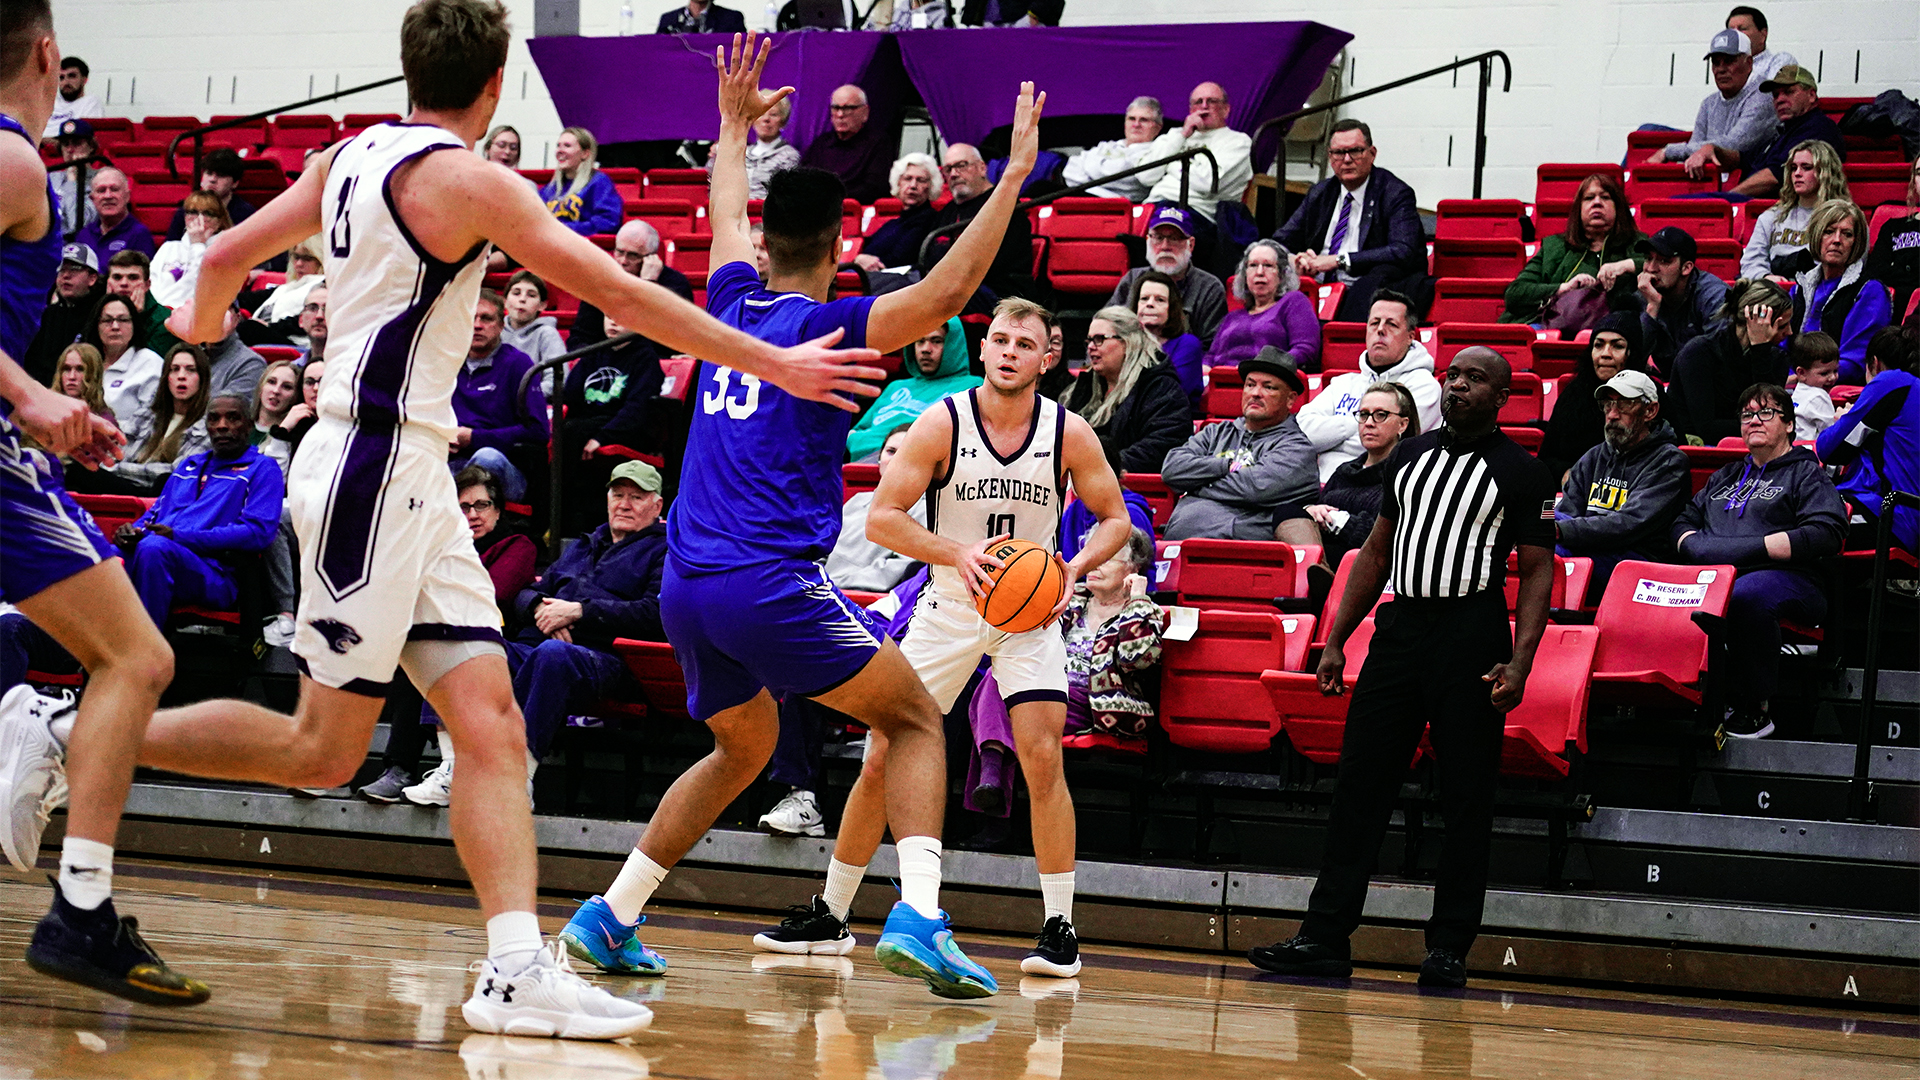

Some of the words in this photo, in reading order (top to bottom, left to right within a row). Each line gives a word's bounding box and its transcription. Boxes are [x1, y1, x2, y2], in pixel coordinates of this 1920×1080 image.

[703, 365, 761, 420] 33
[955, 478, 1051, 506] McKENDREE
[986, 513, 1016, 540] 10
[1657, 585, 1695, 594] RESERV
[1888, 721, 1901, 739] D
[1758, 791, 1770, 809] C
[260, 836, 271, 853] A
[1647, 864, 1660, 882] B
[1503, 946, 1517, 966] A
[1843, 975, 1859, 997] A
